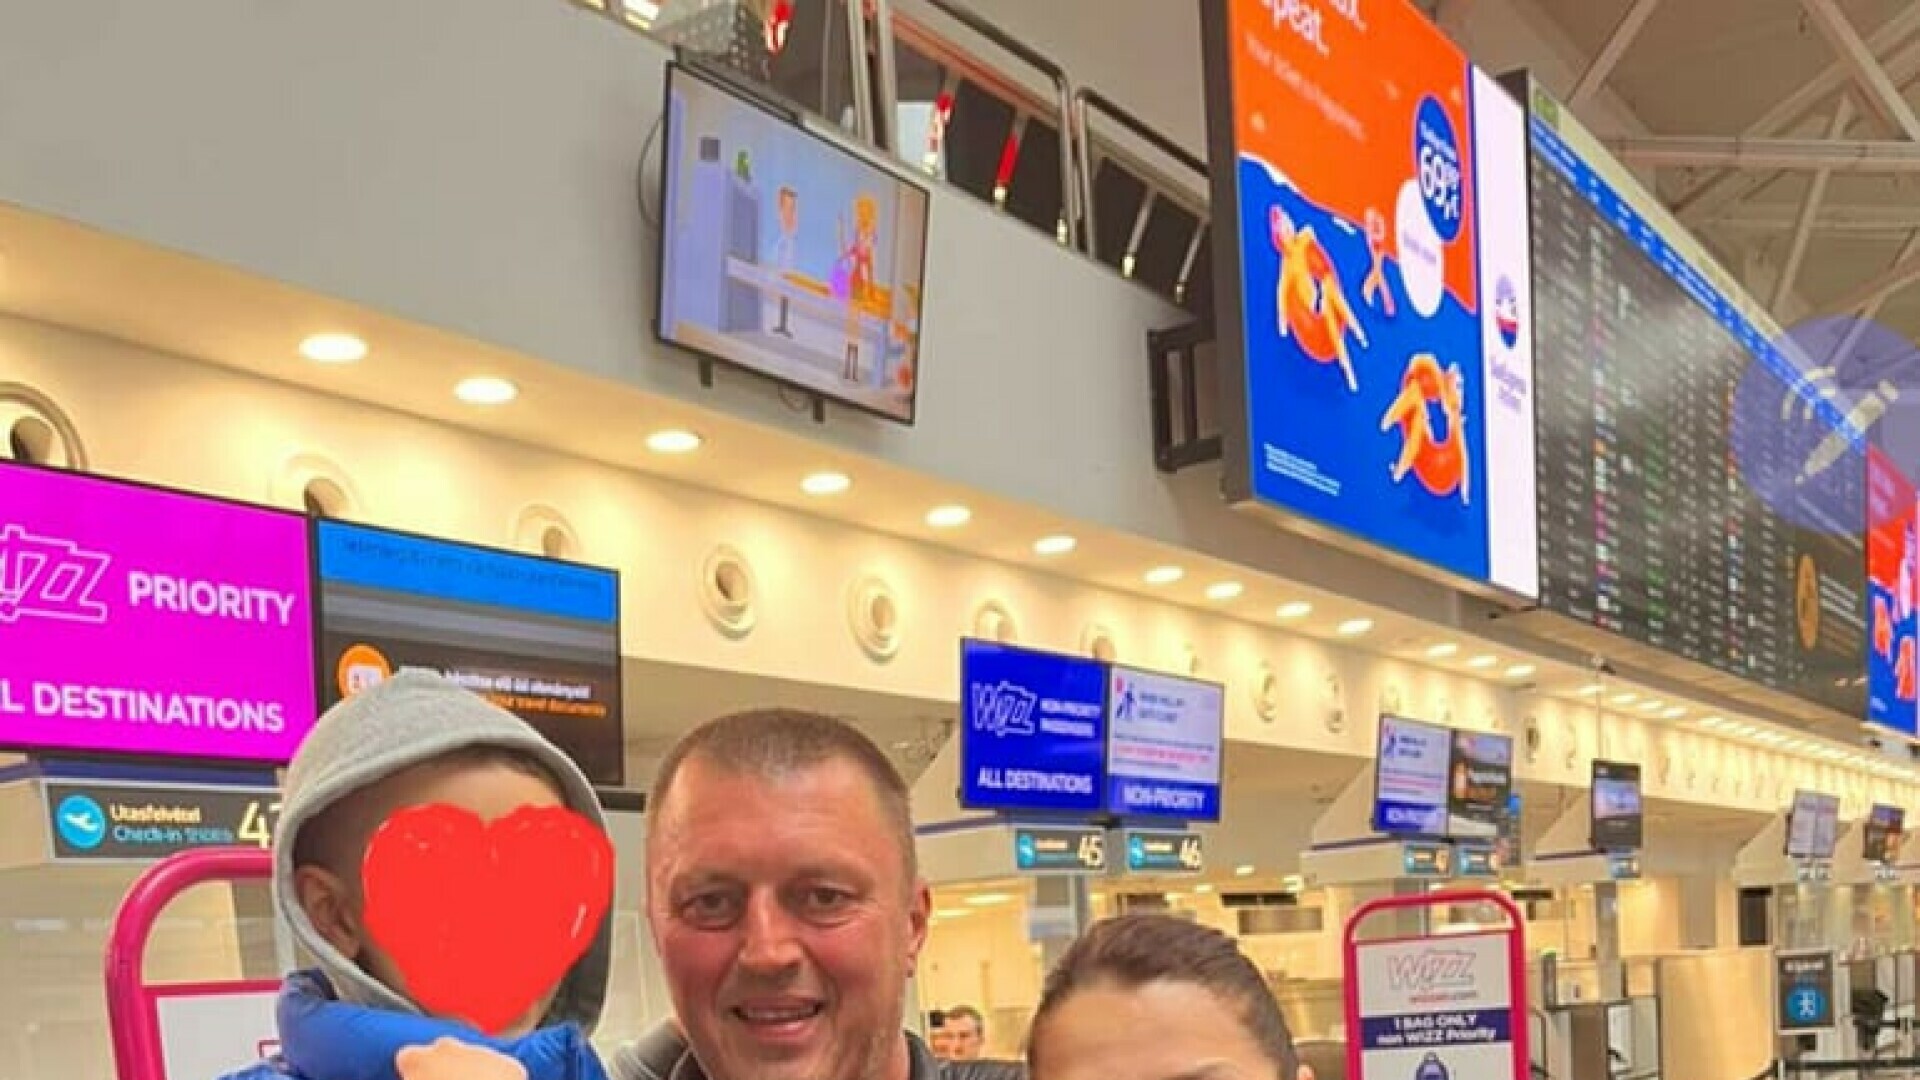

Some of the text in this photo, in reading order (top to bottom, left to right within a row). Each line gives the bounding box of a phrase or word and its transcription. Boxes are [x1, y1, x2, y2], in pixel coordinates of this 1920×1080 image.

[128, 571, 295, 626] PRIORITY
[32, 681, 285, 733] DESTINATIONS
[977, 766, 1093, 794] ALL DESTINATIONS
[113, 826, 183, 844] Check-in
[1078, 834, 1103, 866] 45
[1404, 1015, 1435, 1029] BAG
[1436, 1013, 1477, 1027] ONLY
